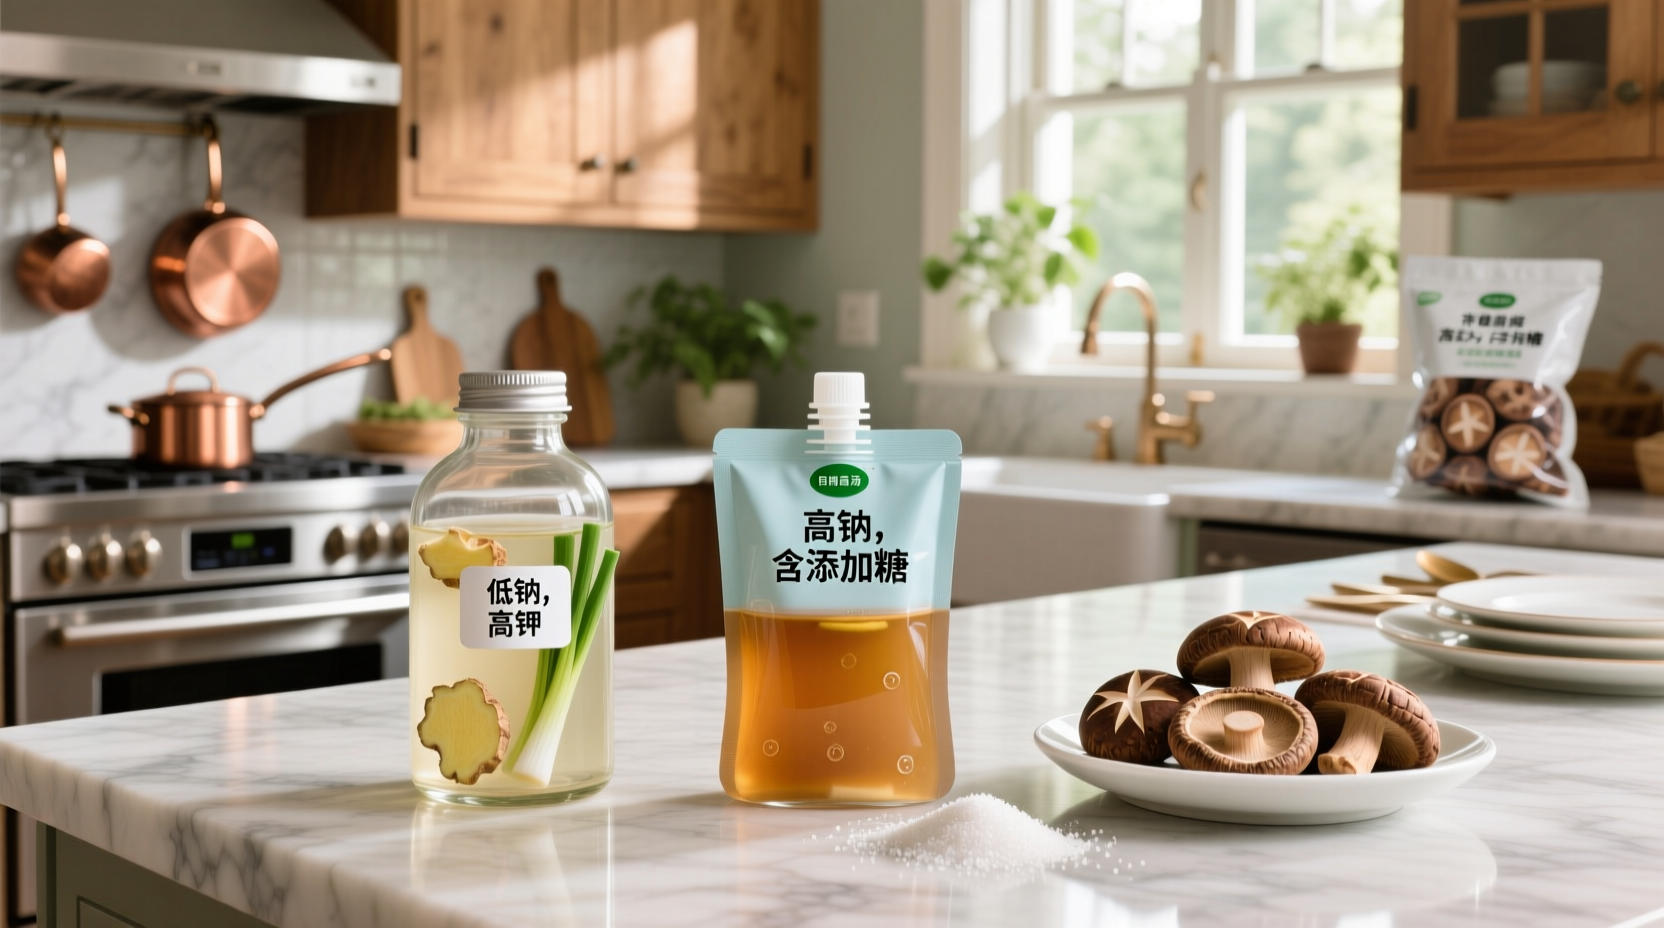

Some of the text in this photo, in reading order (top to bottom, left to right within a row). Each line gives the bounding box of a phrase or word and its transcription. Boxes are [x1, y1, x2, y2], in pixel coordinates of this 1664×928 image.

[803, 508, 884, 545] 高钠,
[772, 547, 909, 585] 含添加糖
[486, 577, 550, 607] 低钠,
[488, 609, 541, 638] 高钾
